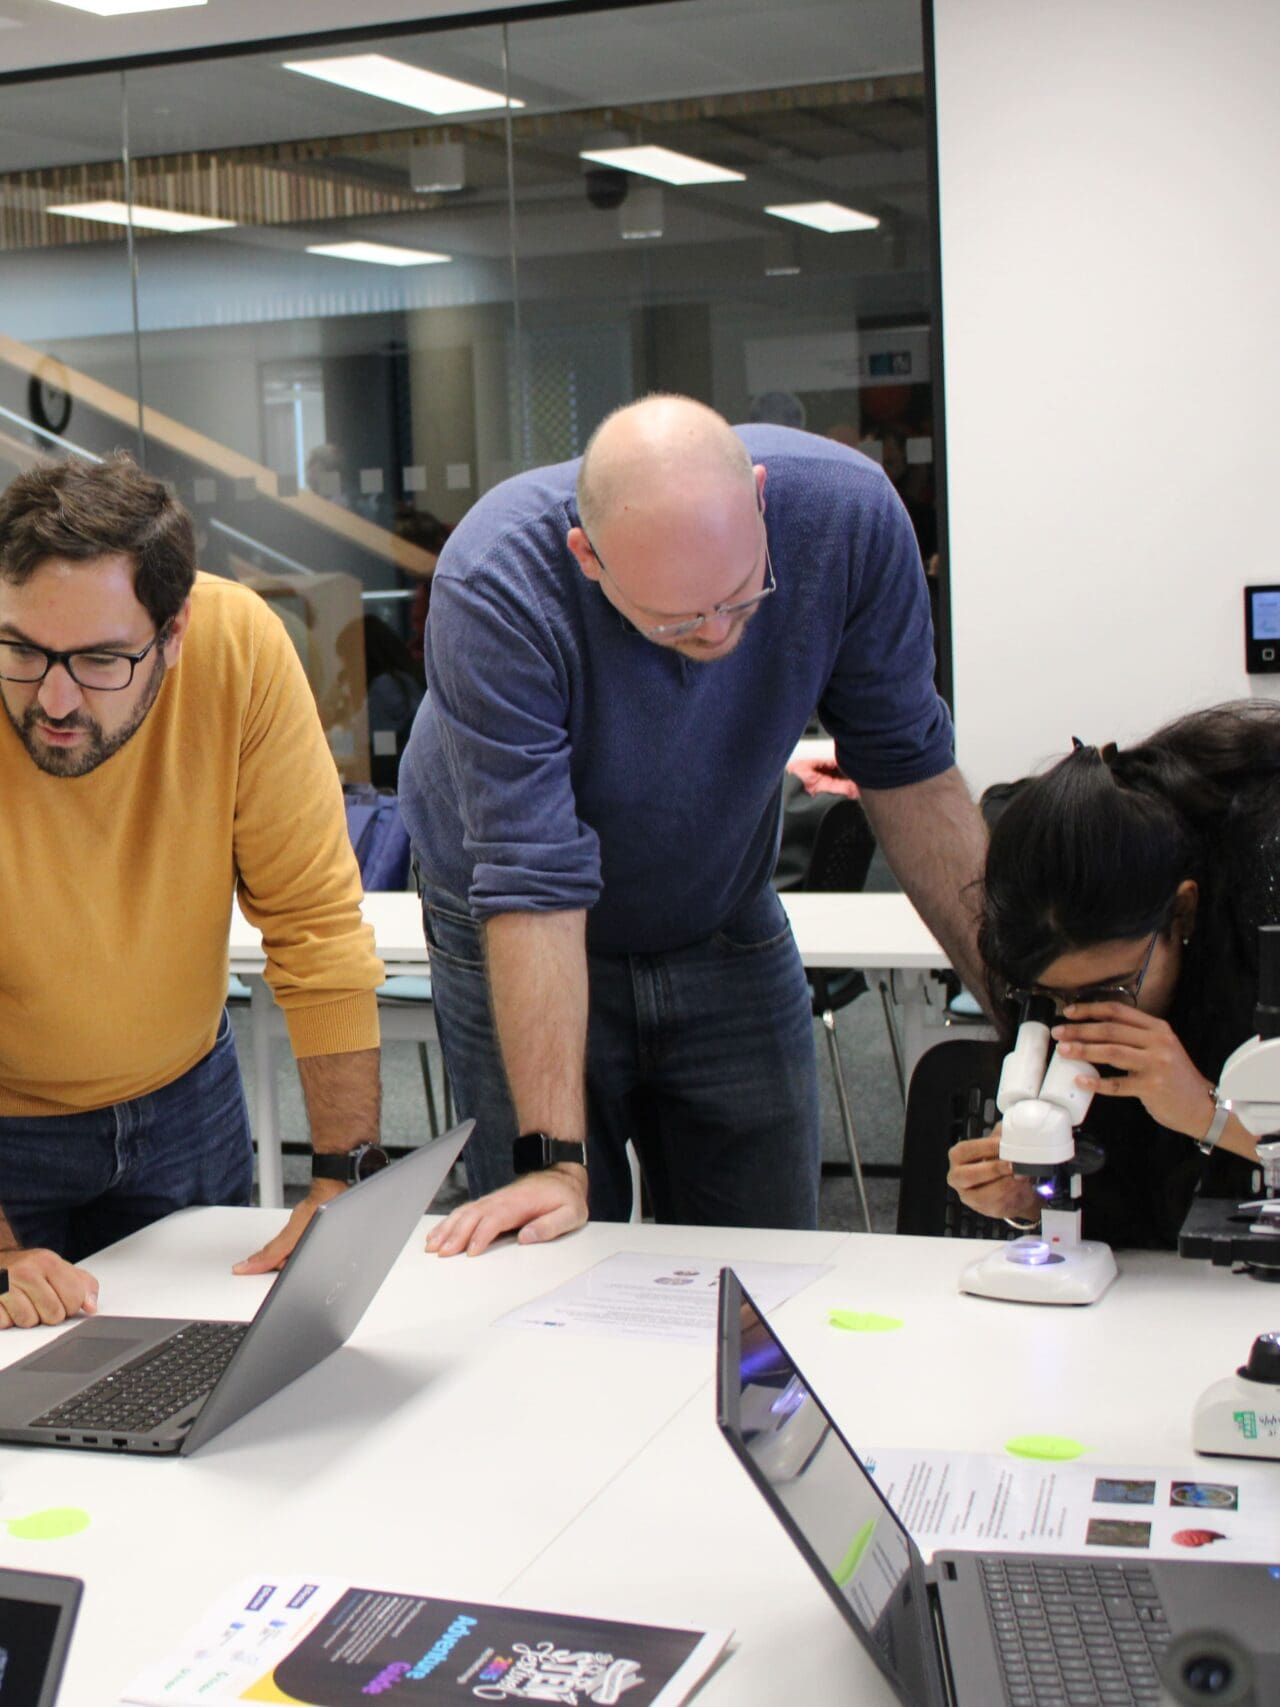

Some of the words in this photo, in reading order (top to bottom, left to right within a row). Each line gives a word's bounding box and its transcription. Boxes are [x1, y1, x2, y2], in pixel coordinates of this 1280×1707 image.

[406, 1614, 477, 1679] Adventure
[472, 1642, 554, 1699] Festival
[362, 1661, 412, 1695] Guide
[524, 1650, 593, 1705] STEM
